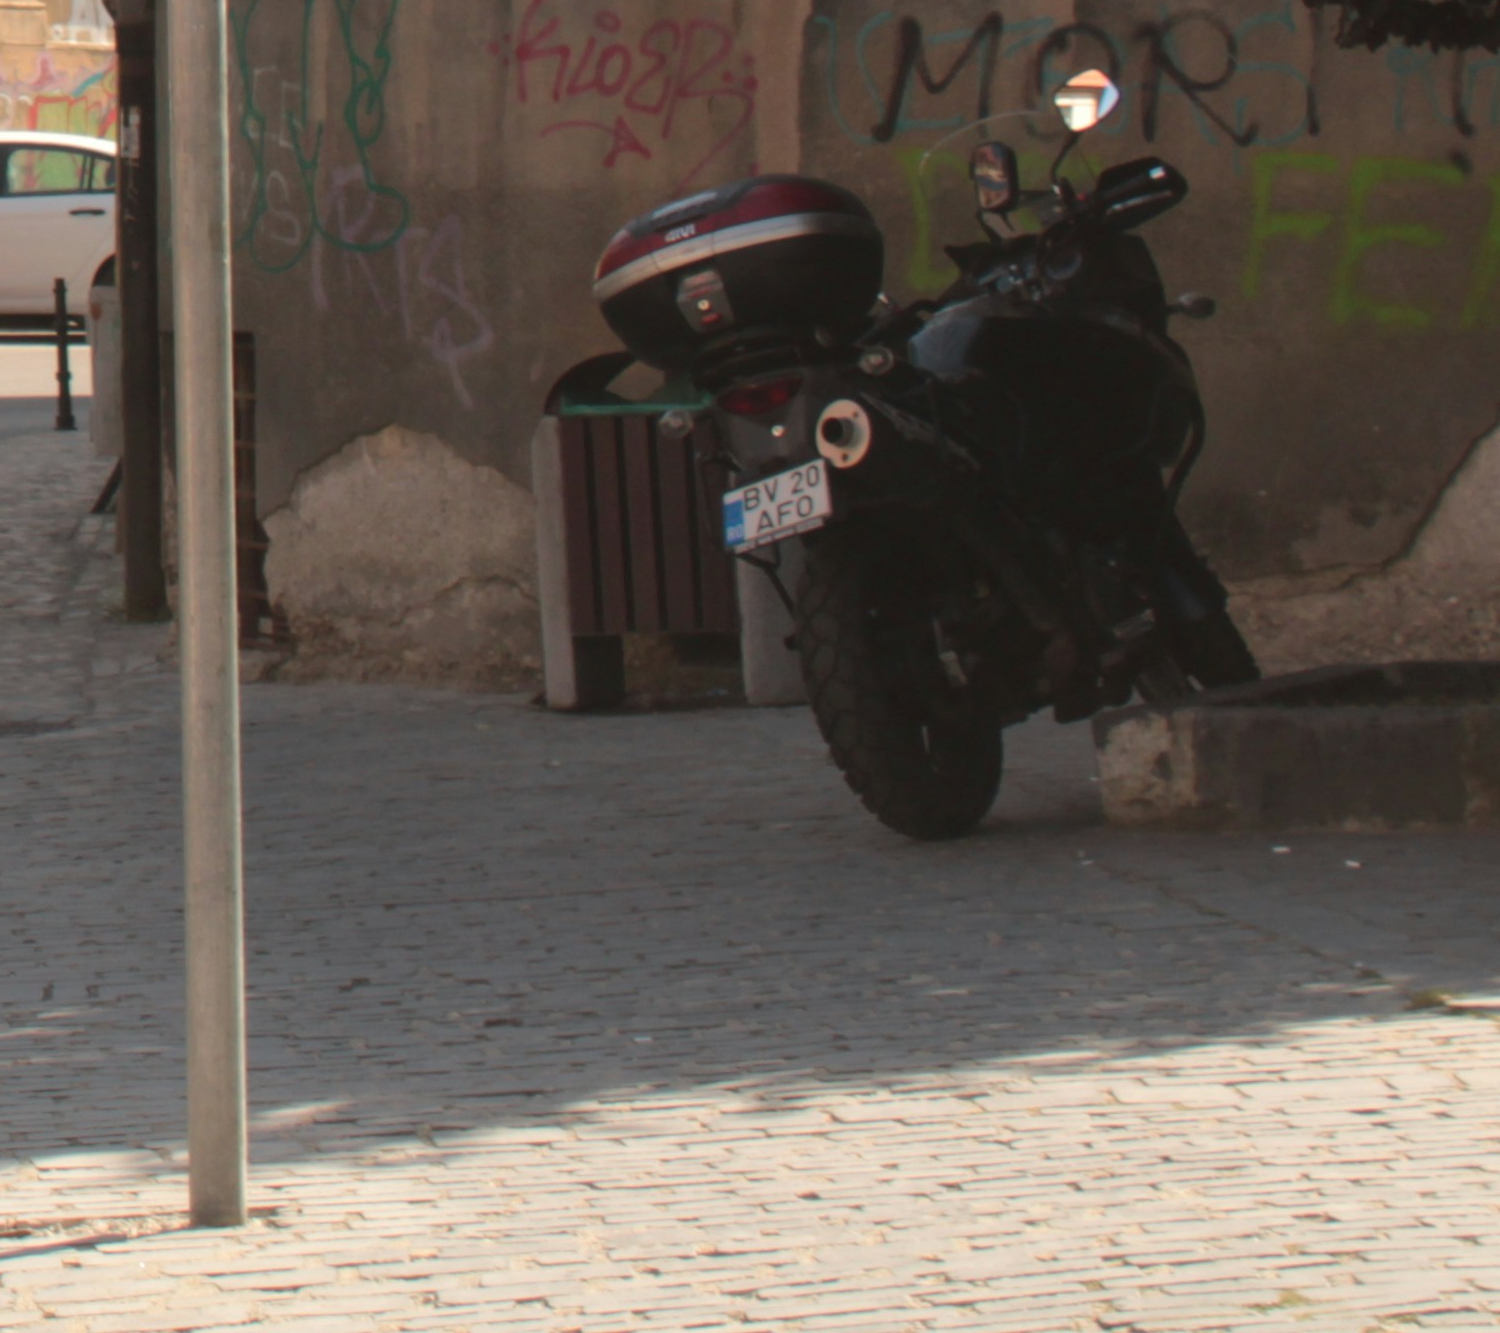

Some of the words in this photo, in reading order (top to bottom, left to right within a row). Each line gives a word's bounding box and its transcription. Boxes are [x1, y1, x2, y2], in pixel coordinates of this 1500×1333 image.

[744, 479, 779, 511] BV
[790, 464, 820, 495] 20
[757, 494, 813, 533] AFO
